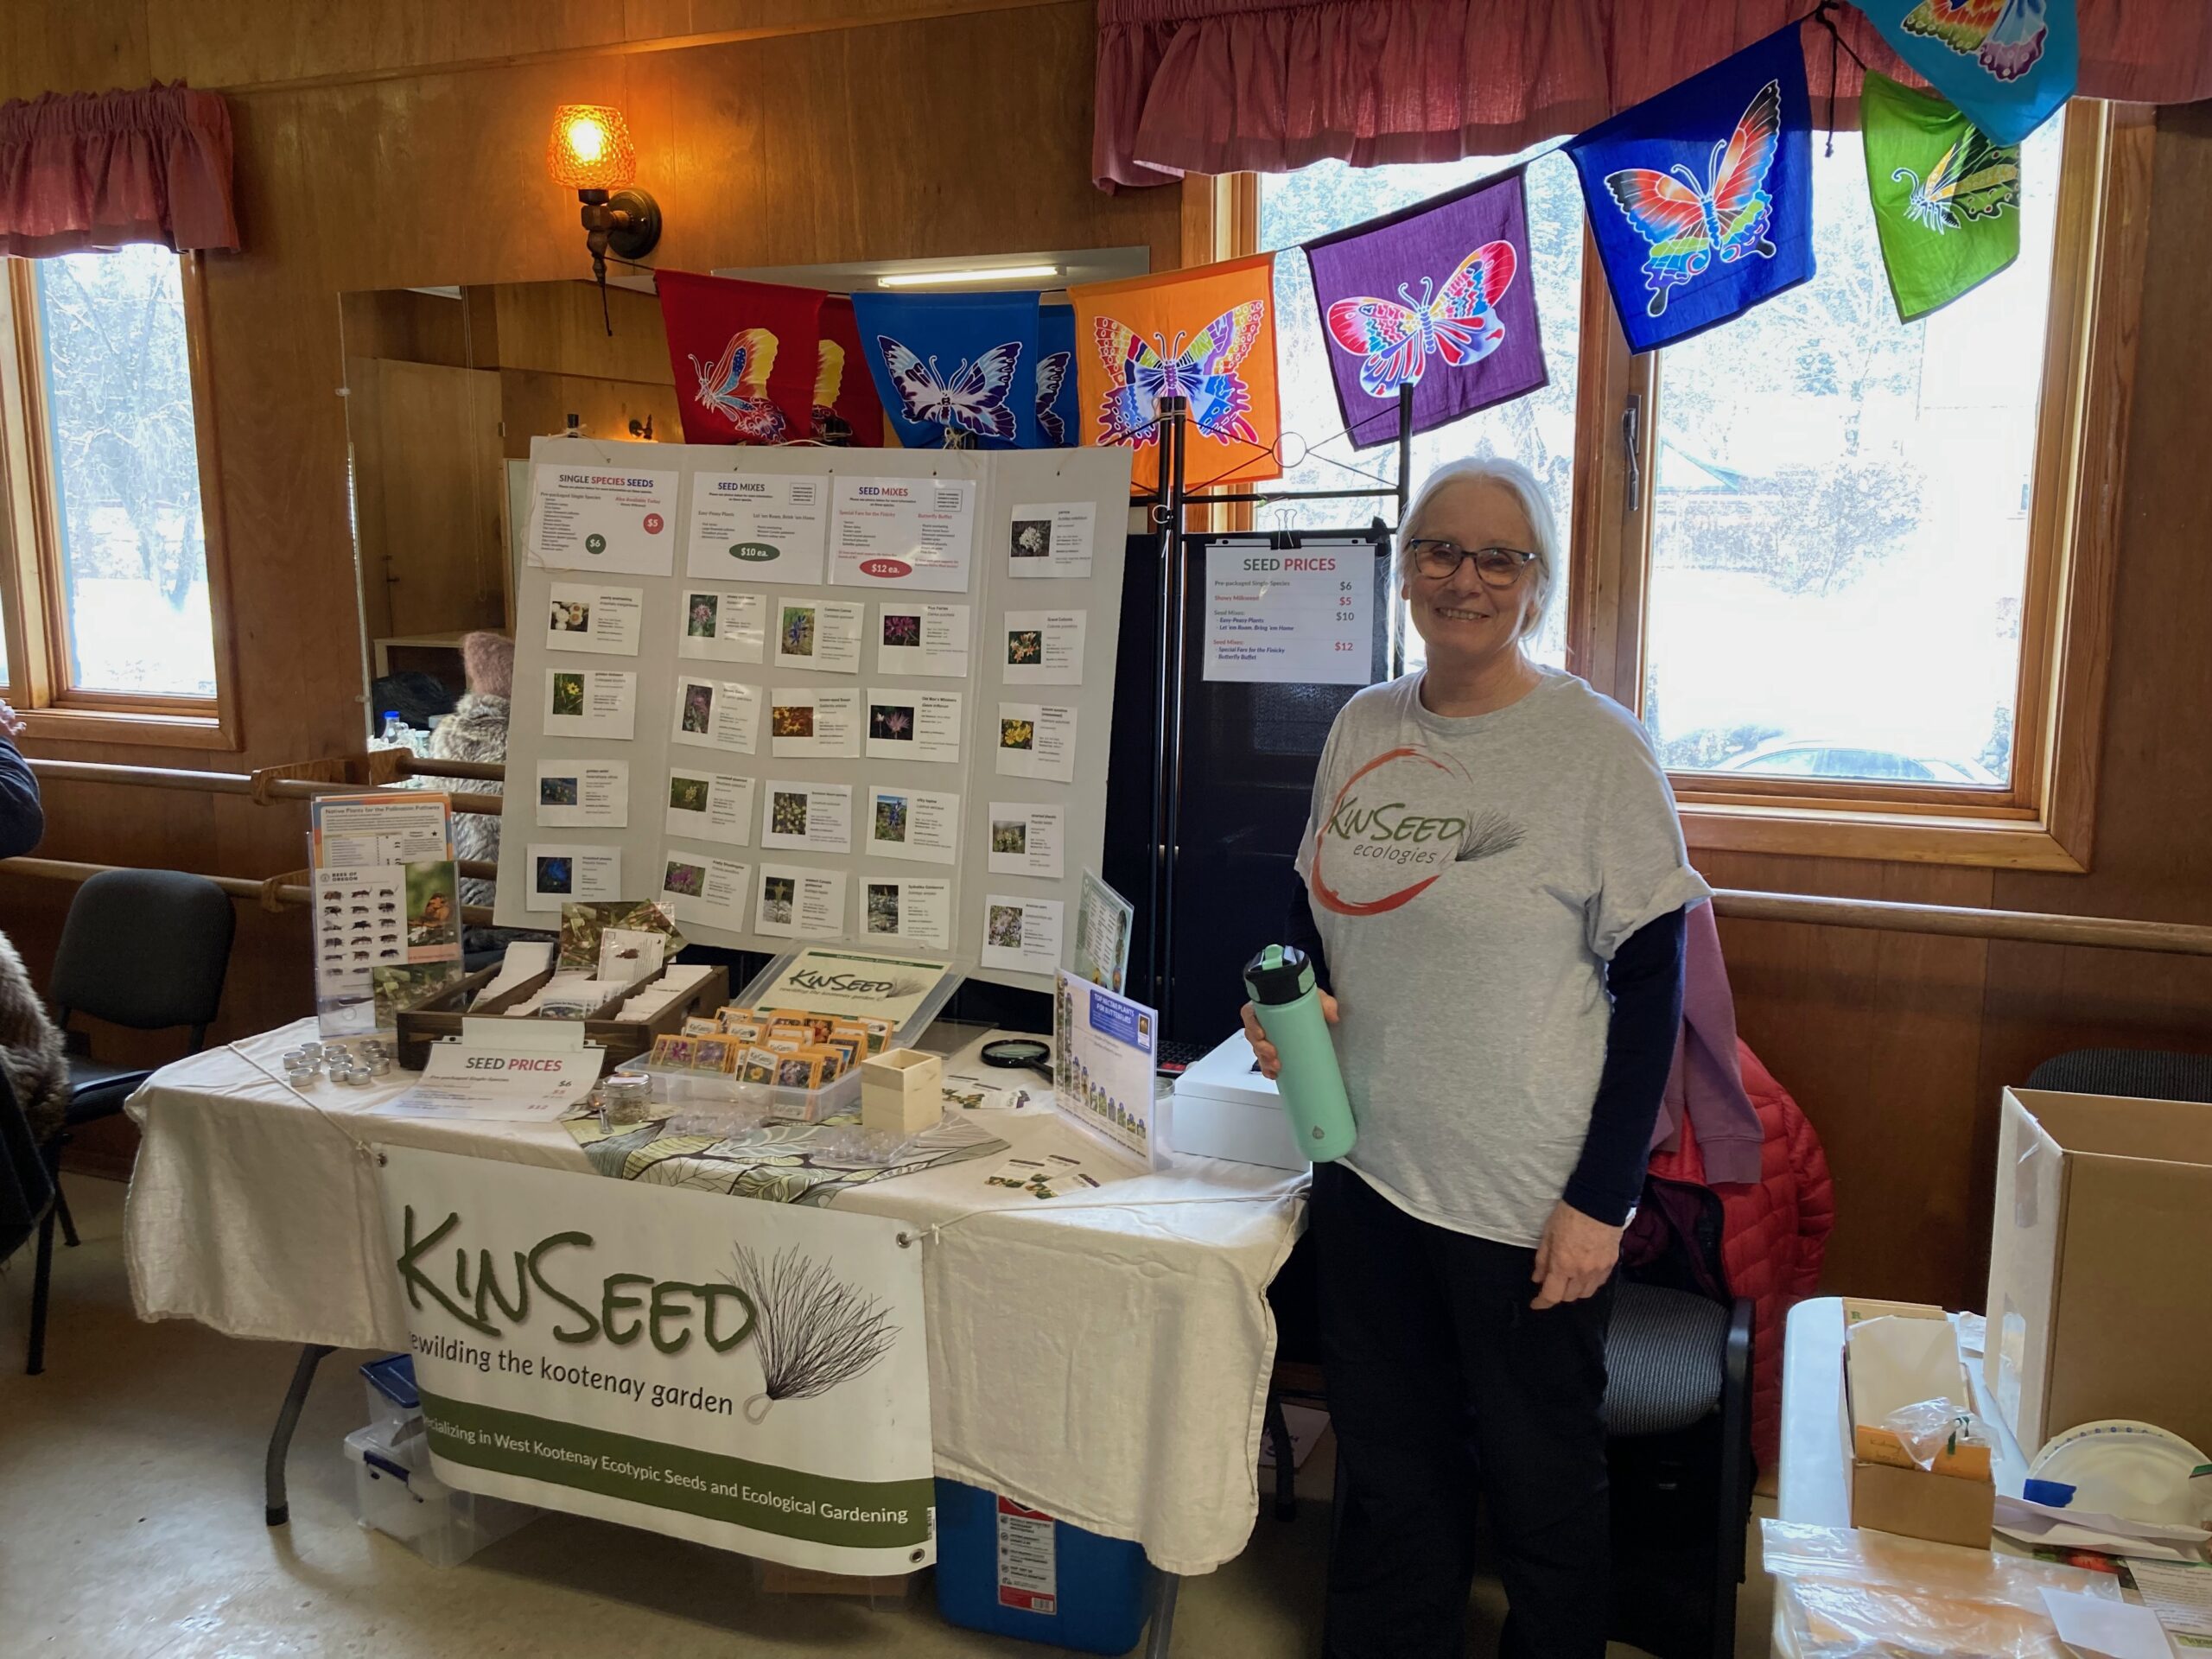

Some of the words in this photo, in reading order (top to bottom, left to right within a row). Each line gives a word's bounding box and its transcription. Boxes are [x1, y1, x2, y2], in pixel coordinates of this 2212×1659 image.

[559, 474, 589, 484] SINGLE
[591, 476, 626, 486] SPECIES
[626, 479, 654, 487] SEEDS
[718, 482, 738, 491] SEED
[740, 483, 765, 492] MIXES
[859, 486, 880, 495] SEED
[881, 488, 908, 497] MIXES
[647, 518, 658, 527] $5
[589, 538, 601, 548] $6
[741, 547, 756, 556] $10
[871, 563, 887, 573] $12
[1243, 558, 1281, 571] SEED
[1284, 558, 1336, 571] PRICES
[1340, 581, 1352, 591] $6
[1339, 596, 1351, 607] $5
[1336, 611, 1355, 621] $10
[1334, 642, 1354, 652] $12
[1353, 842, 1437, 865] ecologies
[1094, 993, 1103, 1002] TOP
[1118, 1005, 1135, 1017] PLANTS
[1096, 1002, 1106, 1012] FOR
[1105, 1007, 1132, 1024] BUTTERFLIES
[466, 1057, 505, 1071] SEED
[508, 1058, 563, 1072] PRICES
[409, 1332, 491, 1372] ewilding
[499, 1349, 533, 1376] the
[541, 1356, 645, 1402] kootenay
[652, 1386, 733, 1415] garden
[480, 1428, 492, 1445] in
[494, 1433, 530, 1454] West
[533, 1440, 598, 1470] Kootenay
[601, 1455, 661, 1481] Ecotypic
[664, 1469, 707, 1492] Seeds
[711, 1482, 738, 1497] and
[742, 1486, 816, 1516] Ecological
[820, 1503, 909, 1524] Gardening
